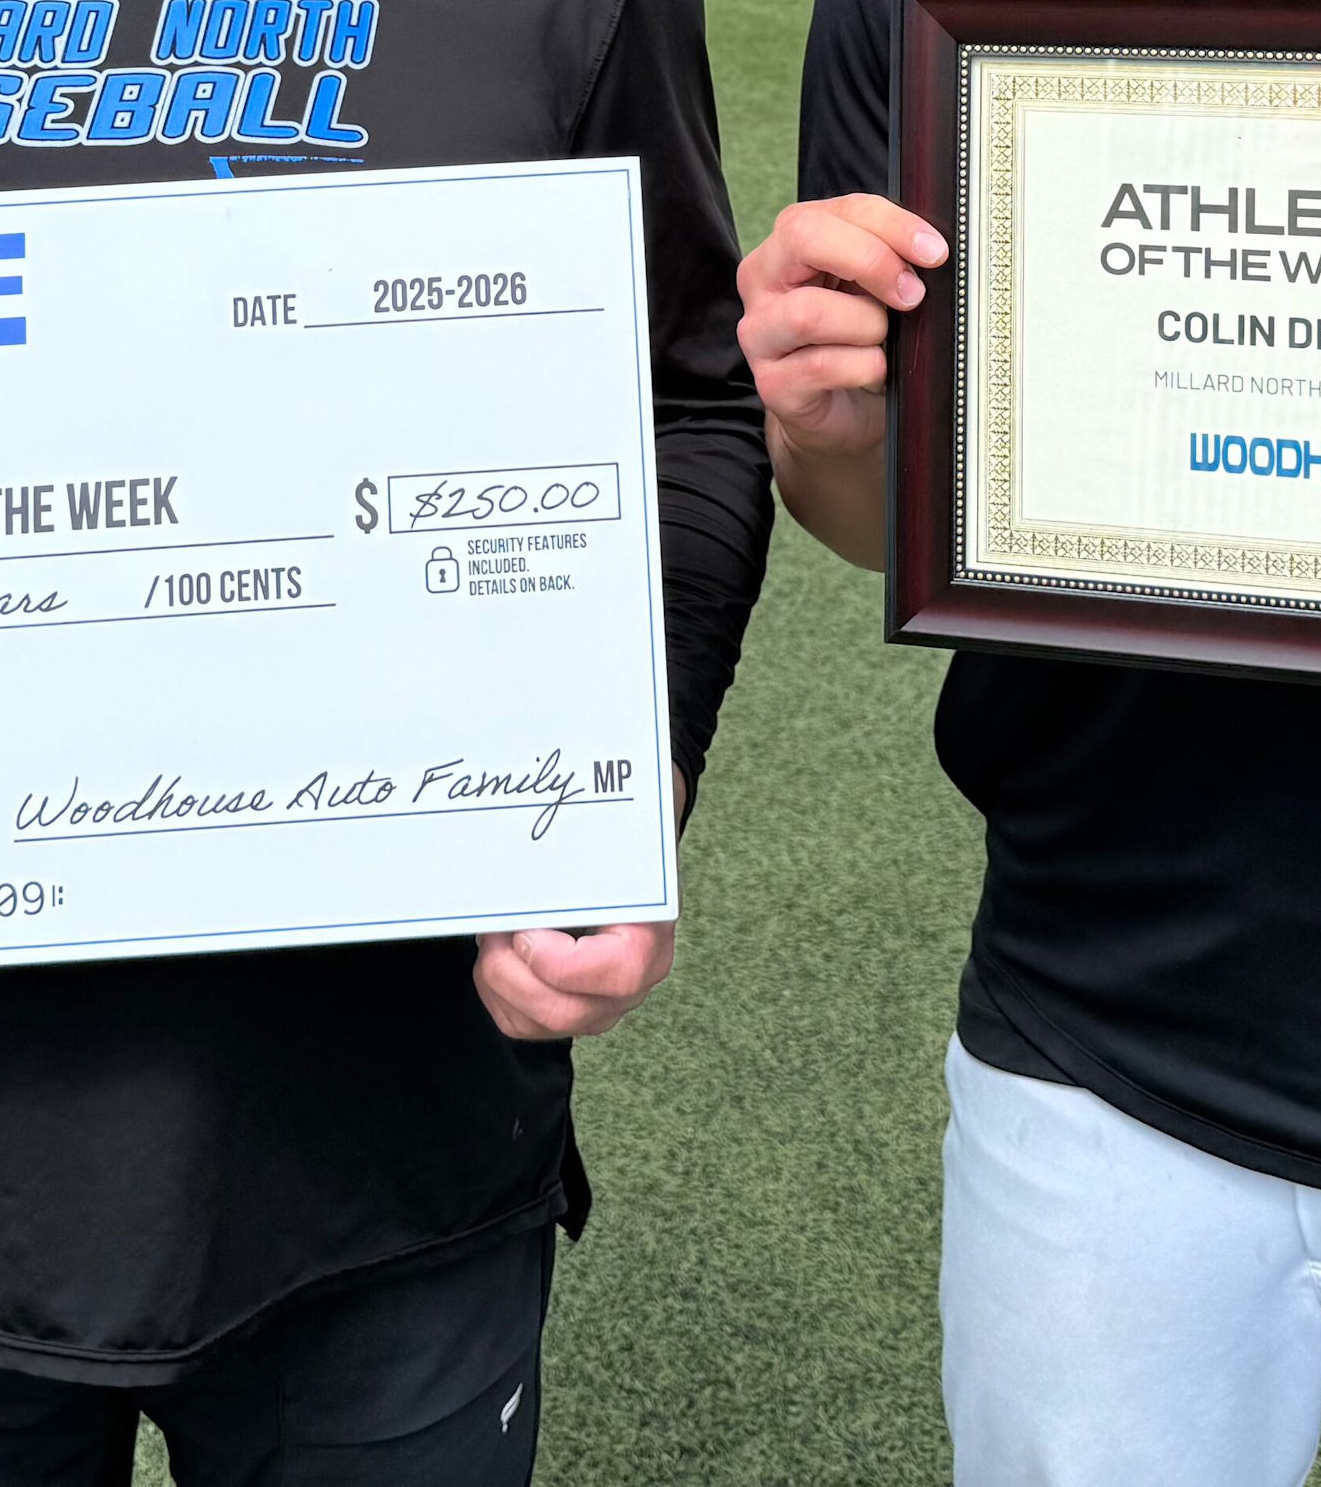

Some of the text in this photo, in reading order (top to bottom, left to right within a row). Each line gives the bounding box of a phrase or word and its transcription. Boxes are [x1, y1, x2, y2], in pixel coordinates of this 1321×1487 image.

[1100, 242, 1164, 277] OF
[1171, 246, 1272, 283] THE
[233, 272, 527, 328] DATE 2025-2026
[1157, 311, 1276, 348] COLIN
[1154, 370, 1245, 394] MILLARD
[1250, 375, 1321, 398] NORTH
[67, 476, 178, 532] WEEK
[355, 477, 599, 534] $ $250.00
[468, 533, 587, 555] SECURITY FEATURES
[469, 558, 530, 575] INCLUDED.
[469, 575, 575, 596] DETAILS ON BACK.
[144, 574, 211, 609] /100
[220, 566, 302, 604] CENTS
[17, 748, 632, 841] Woodhouse Auto Family MP
